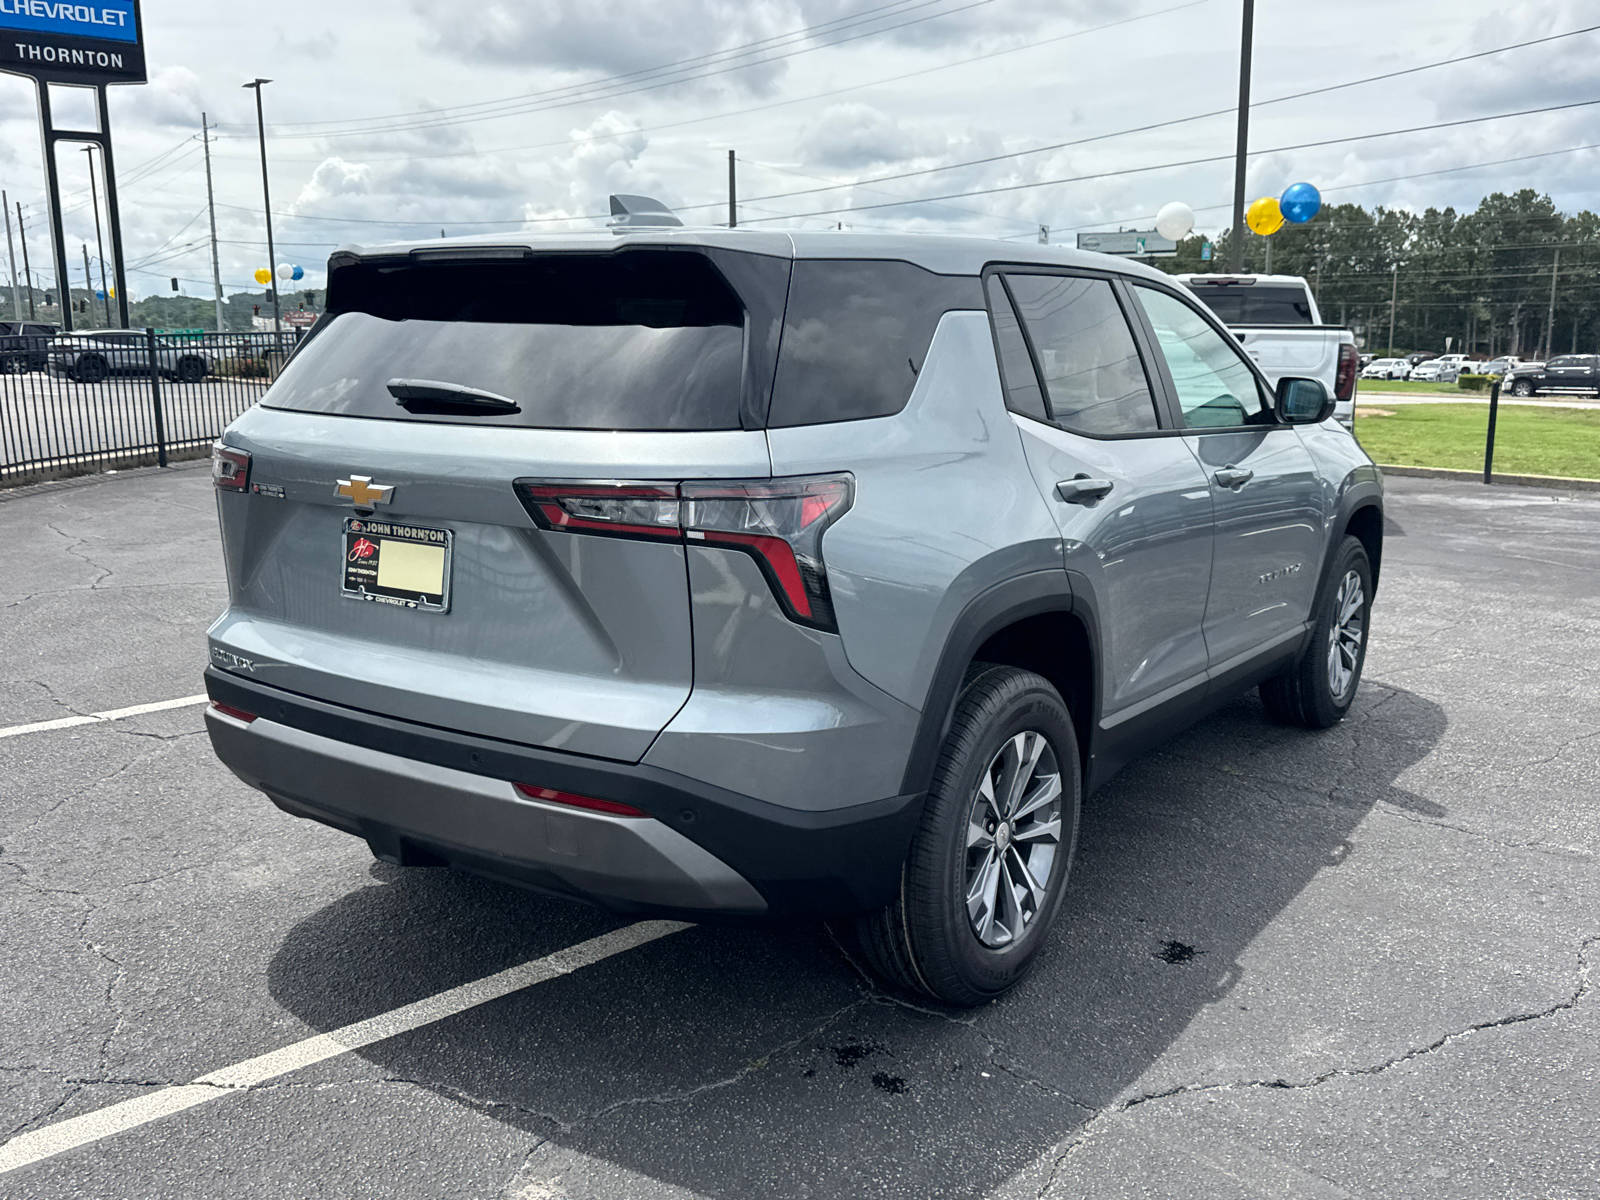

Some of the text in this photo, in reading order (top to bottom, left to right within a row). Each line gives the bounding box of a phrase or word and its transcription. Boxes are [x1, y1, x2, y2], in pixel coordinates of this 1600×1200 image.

[15, 43, 123, 69] THORNTON
[366, 522, 391, 535] JOHN
[392, 525, 445, 542] THORNTON
[375, 596, 407, 607] CHEVROLET
